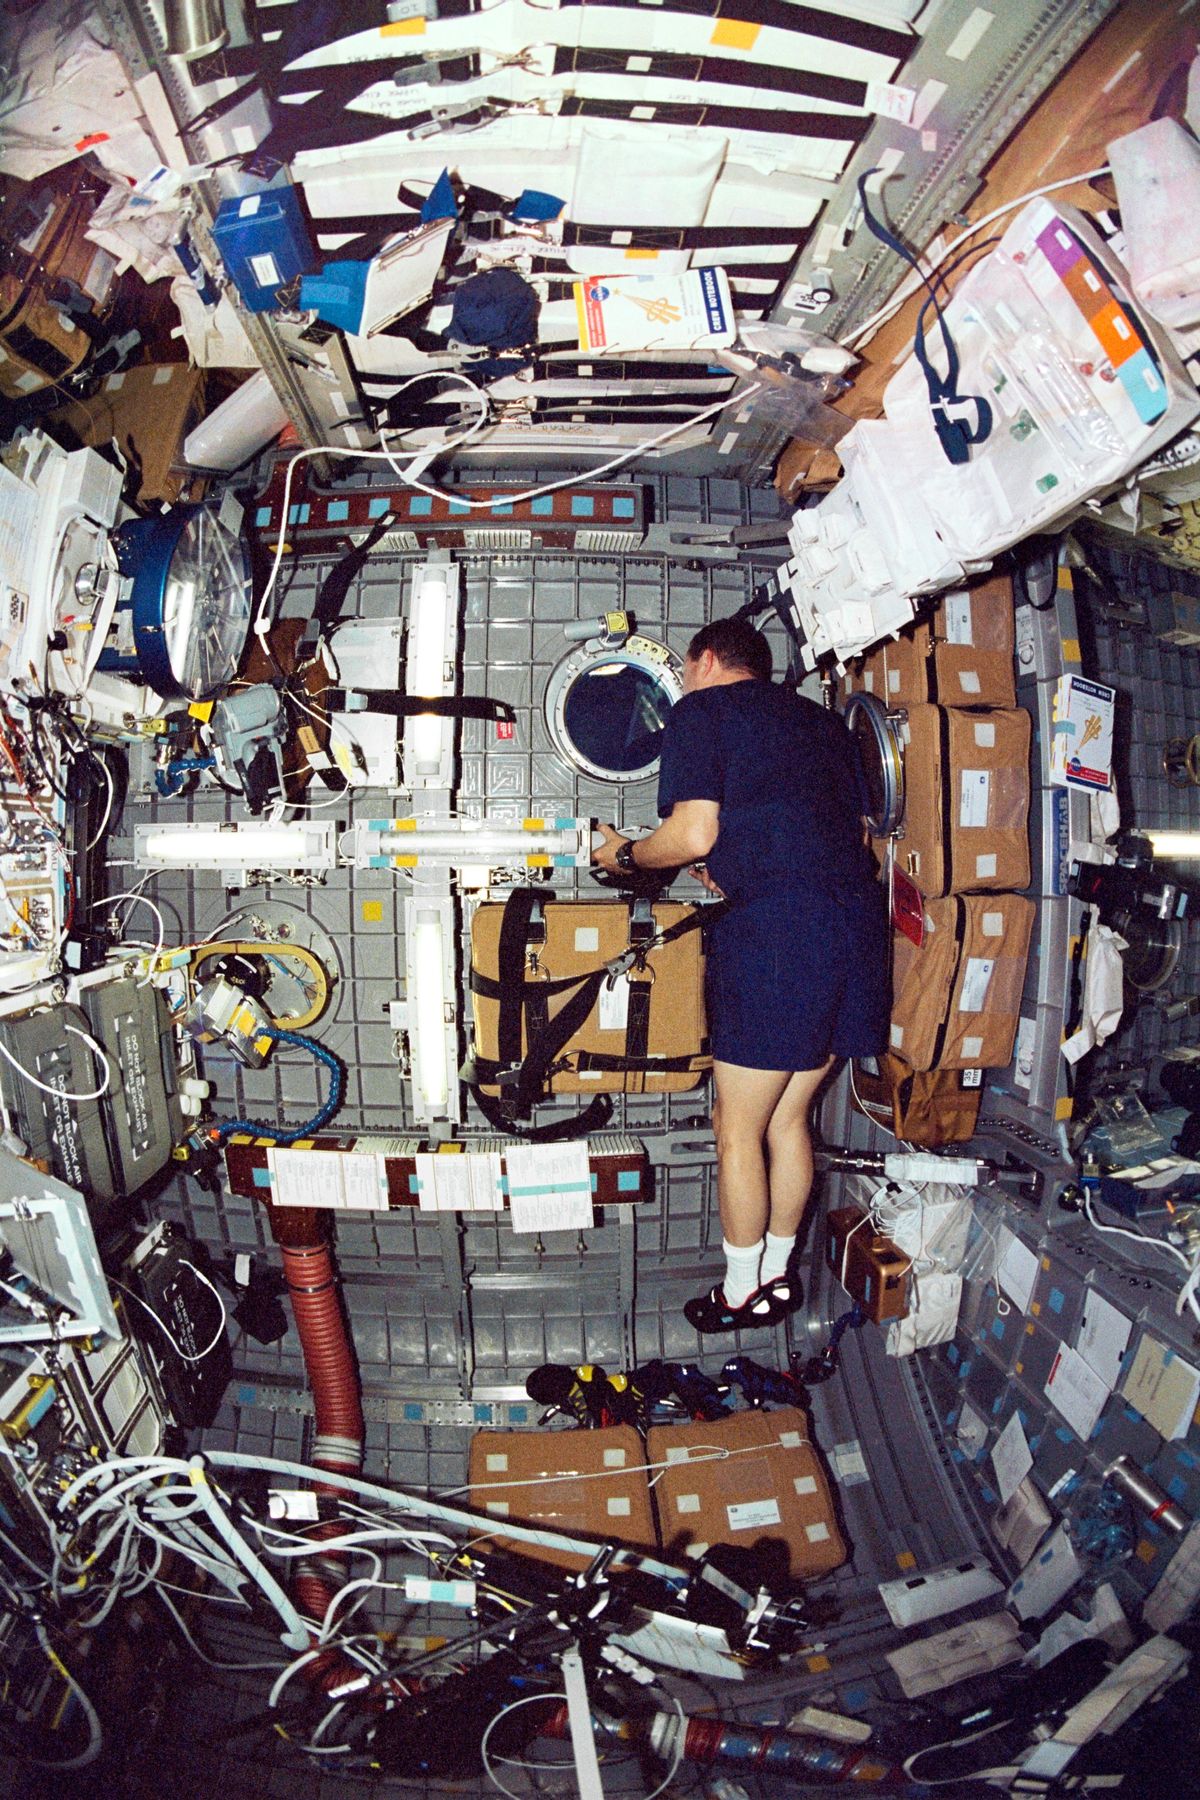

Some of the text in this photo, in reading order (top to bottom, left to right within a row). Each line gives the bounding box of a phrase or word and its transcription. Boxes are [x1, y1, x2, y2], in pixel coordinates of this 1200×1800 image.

[704, 272, 722, 331] CREW NOTEBOOK
[1059, 797, 1069, 894] SPACEHAB
[131, 1034, 139, 1051] DO
[133, 1053, 141, 1074] NOT
[963, 1069, 979, 1084] 35 mm
[124, 1037, 142, 1133] INLET OR EXHAUST
[135, 1076, 145, 1111] BLOCK
[55, 1115, 64, 1134] OR
[58, 1074, 82, 1184] DO NOT BLOCK AIR
